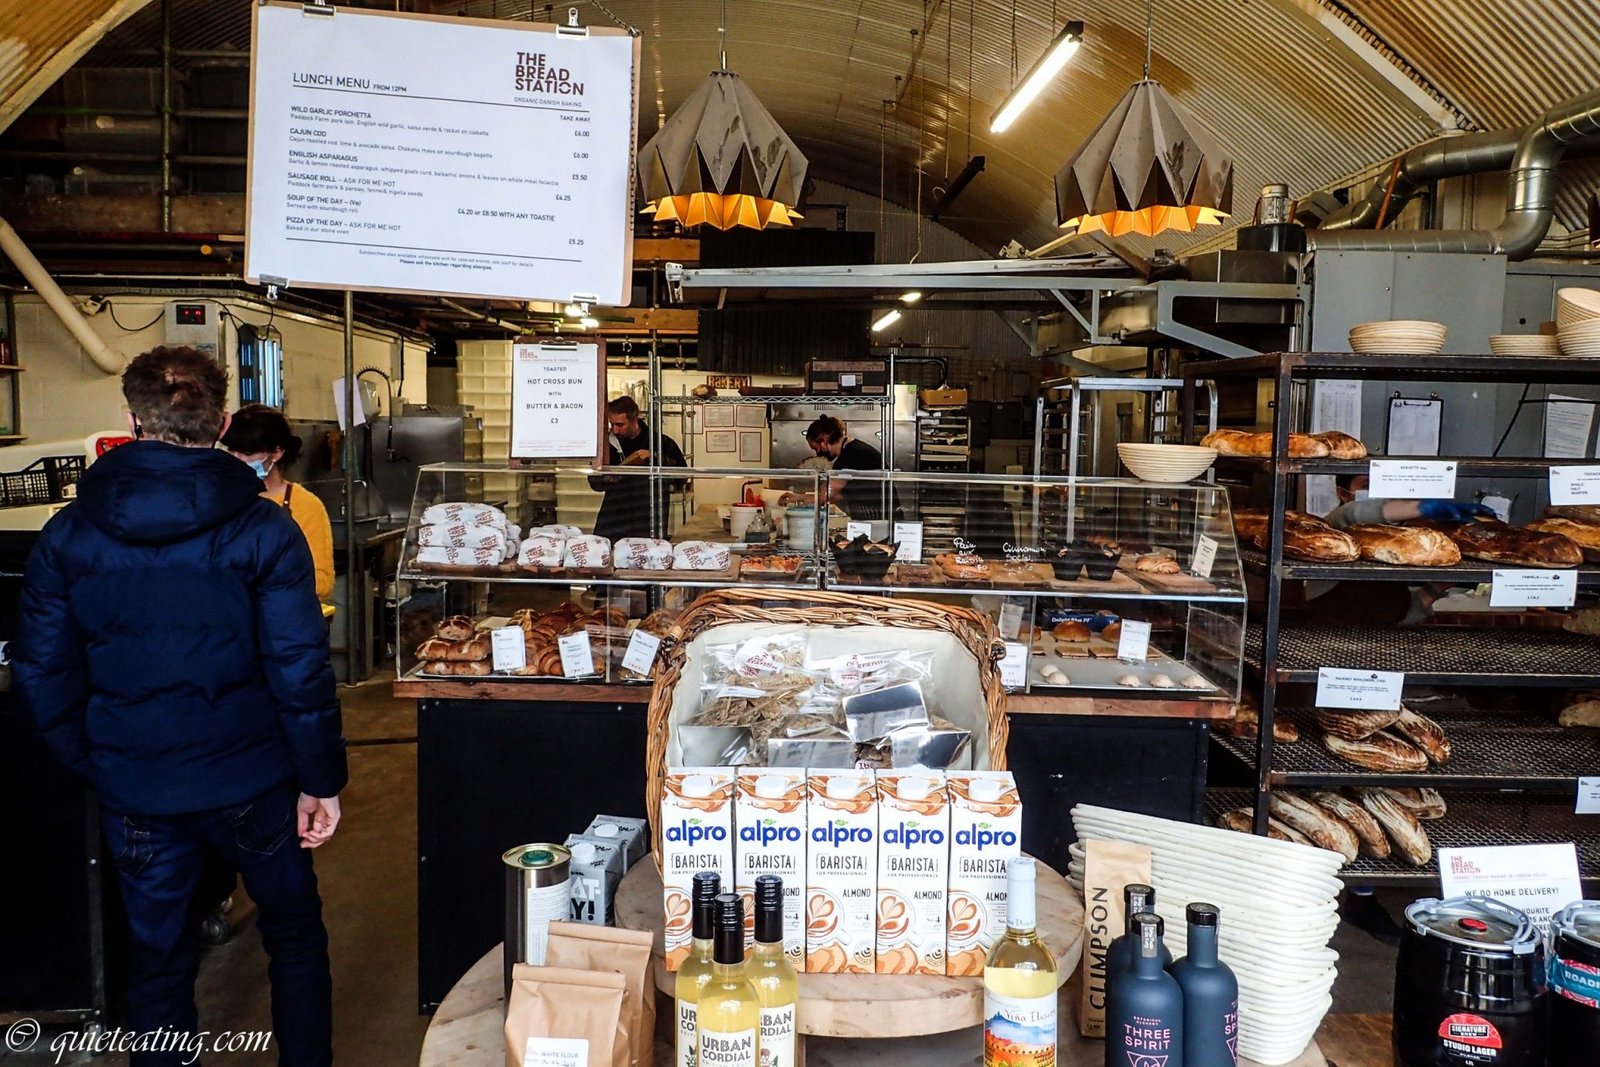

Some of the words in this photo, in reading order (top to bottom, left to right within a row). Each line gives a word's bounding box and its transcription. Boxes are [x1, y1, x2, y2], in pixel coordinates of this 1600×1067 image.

[517, 52, 546, 66] THE
[516, 64, 570, 81] BREAD
[293, 71, 332, 86] LUNCH
[336, 76, 370, 89] MENU
[515, 78, 584, 96] STATION
[290, 105, 308, 113] WILD
[309, 106, 333, 115] GARLIC
[333, 109, 372, 119] PORCHETTA
[289, 127, 312, 135] CAJUN
[288, 149, 317, 158] ENGLISH
[318, 152, 358, 162] ASPARAGUS
[287, 171, 318, 181] SAUSAGE
[286, 193, 305, 201] SOUP
[286, 215, 305, 224] PIZZA
[529, 213, 555, 221] TOASTIE
[1002, 542, 1046, 553] Cinnamon
[666, 819, 726, 846] alpro
[740, 819, 801, 847] alpro
[812, 820, 872, 848] alpro
[883, 822, 944, 849] alpro
[956, 823, 1017, 851] alpro
[675, 854, 718, 869] BARISTA
[749, 855, 792, 869] BARISTA
[820, 856, 863, 870] BARISTA
[891, 858, 934, 872] BARISTA
[963, 859, 1006, 873] BARISTA
[842, 889, 871, 898] ALMOND
[914, 891, 942, 900] ALMOND
[1518, 887, 1559, 896] DELIVERY!
[1089, 887, 1108, 1010] CLIMPSON
[1124, 1024, 1171, 1040] THREE
[702, 1035, 751, 1052] URBAN
[1124, 1036, 1171, 1050] SPIRIT
[1443, 1039, 1470, 1052] STUDIO
[1472, 1046, 1497, 1056] LAGER
[702, 1049, 751, 1062] CORDIAL
